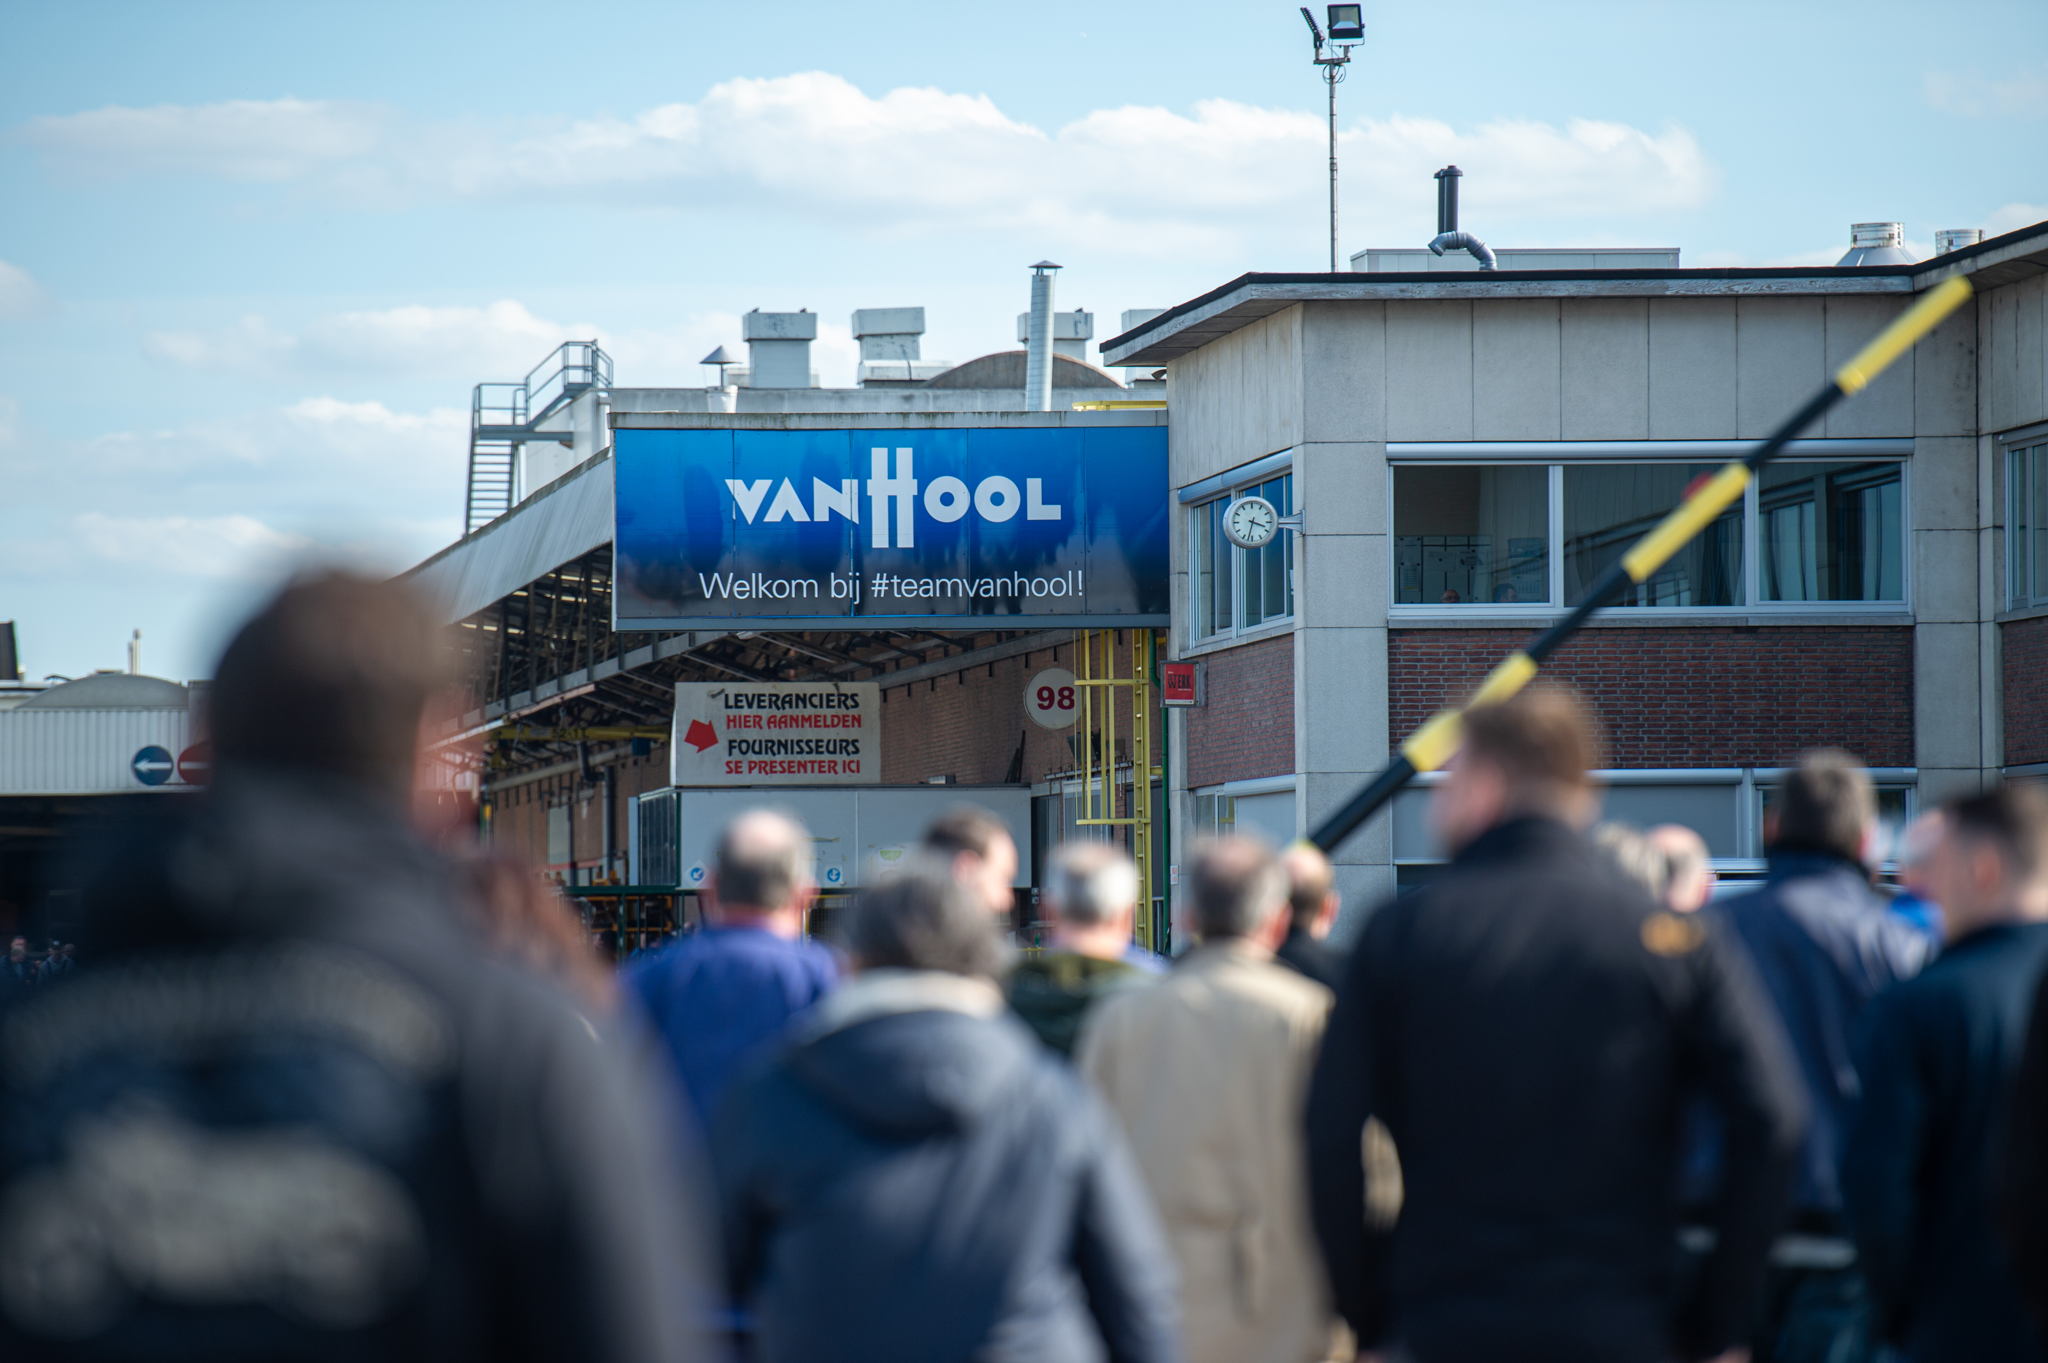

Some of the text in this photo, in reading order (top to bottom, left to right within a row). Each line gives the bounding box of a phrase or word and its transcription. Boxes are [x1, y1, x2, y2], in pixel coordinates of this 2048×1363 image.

[699, 570, 1083, 605] Welkom bij #teamvanhool!
[724, 693, 860, 710] LEVERANCIERS
[1036, 686, 1075, 710] 98
[727, 714, 862, 730] HIER AANMELDEN
[728, 739, 860, 757] FOURNISSEURS
[725, 760, 861, 775] SE PRESENTER ICI
